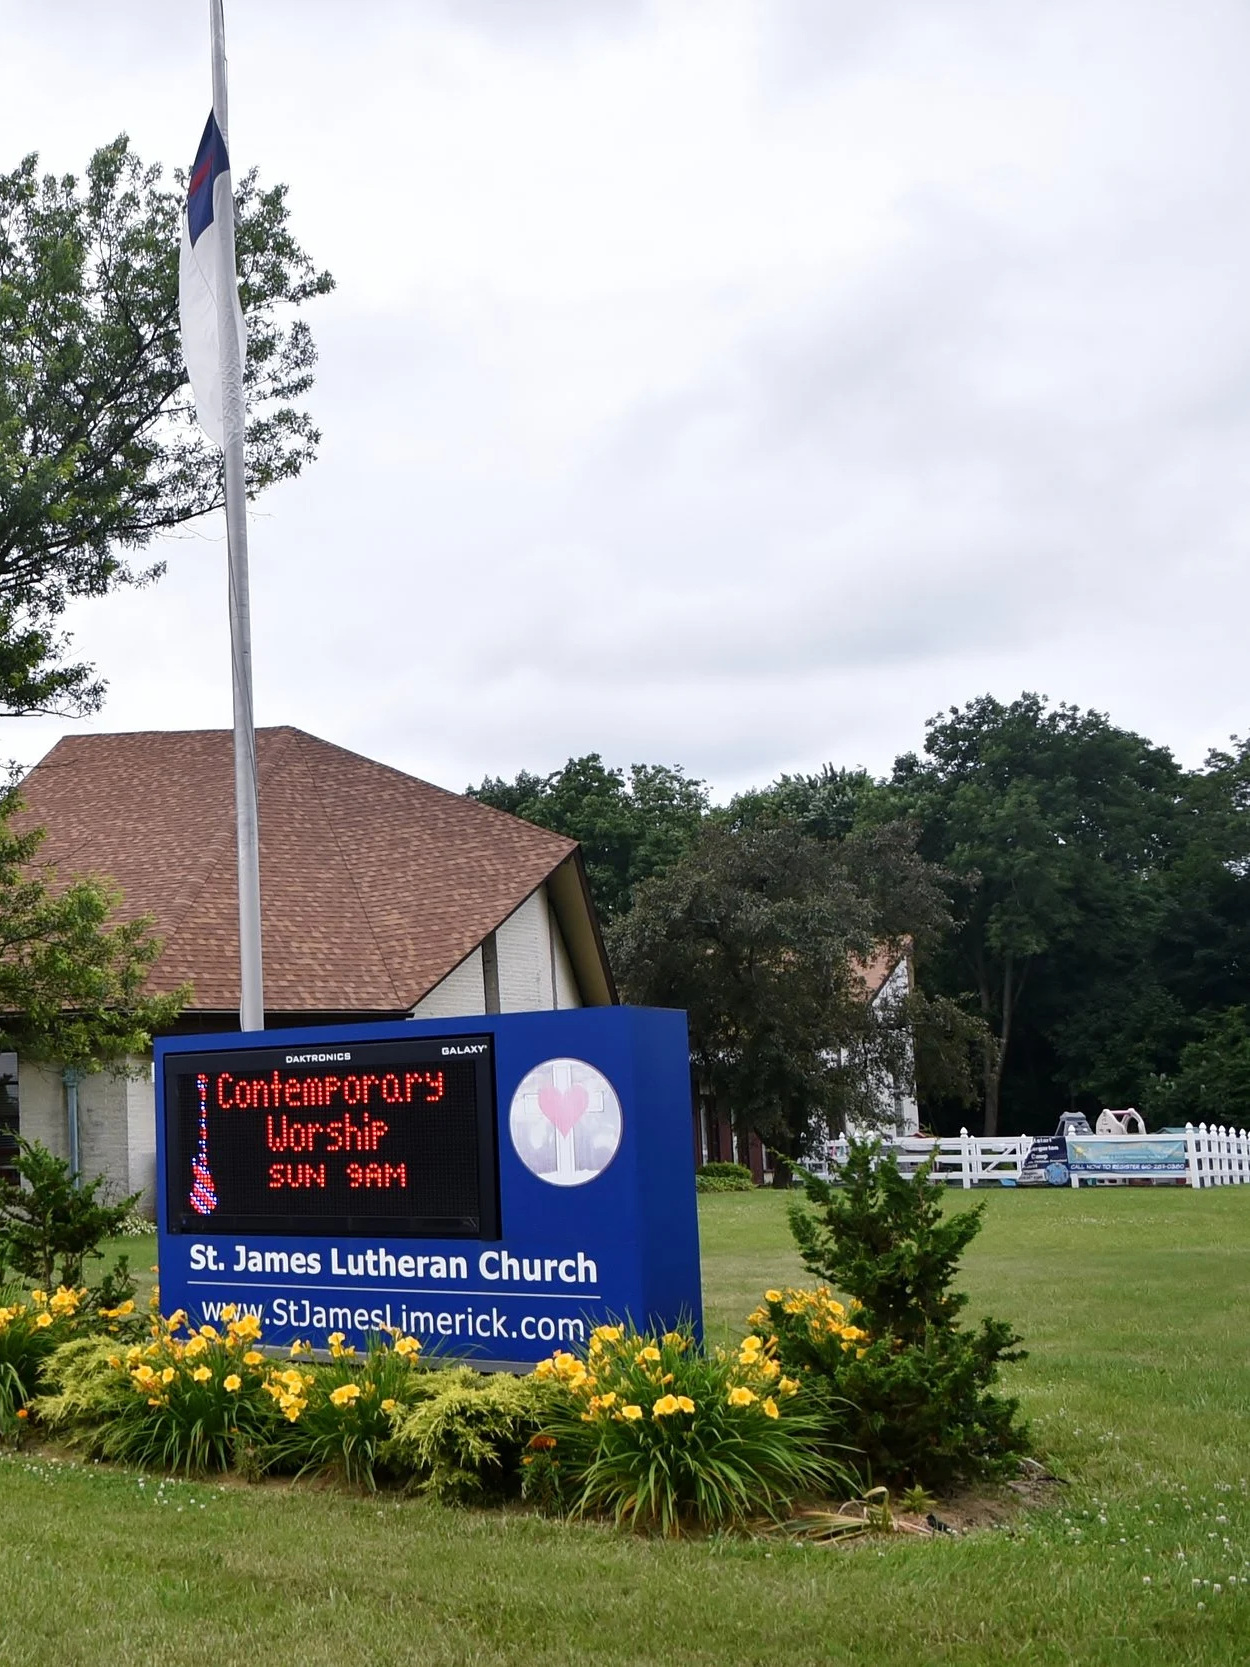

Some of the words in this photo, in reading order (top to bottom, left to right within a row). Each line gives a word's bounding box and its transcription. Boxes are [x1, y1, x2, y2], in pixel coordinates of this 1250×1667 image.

[285, 1052, 351, 1064] DAKTRONICS
[217, 1070, 444, 1109] Contemporary
[267, 1111, 389, 1152] Worship
[268, 1162, 326, 1188] SUN
[346, 1162, 407, 1188] 9AM
[190, 1243, 225, 1271] St.
[233, 1245, 322, 1275] James
[331, 1247, 468, 1279] Lutheran
[478, 1250, 598, 1283] Church
